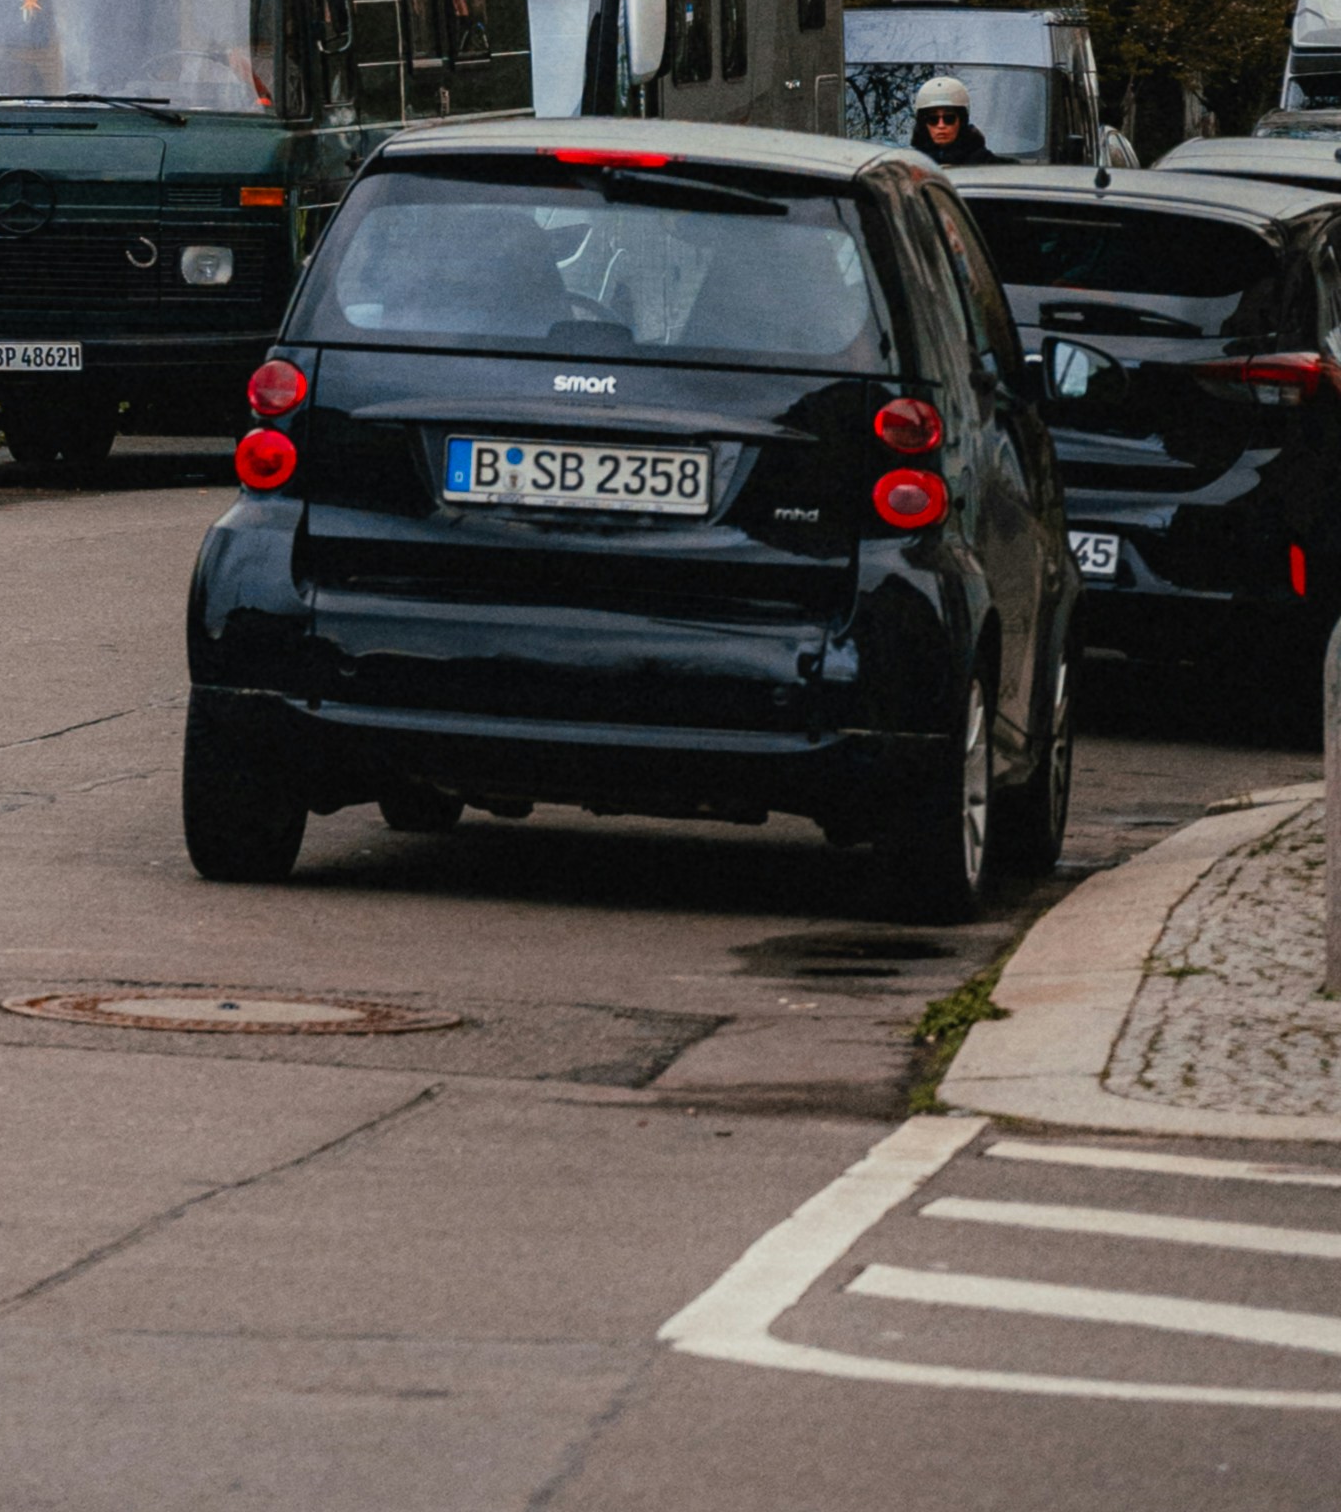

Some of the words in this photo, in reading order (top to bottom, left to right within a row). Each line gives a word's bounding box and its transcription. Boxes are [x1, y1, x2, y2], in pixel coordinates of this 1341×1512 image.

[21, 347, 80, 367] 4862H
[553, 374, 616, 394] smart
[475, 447, 500, 487] B
[531, 451, 584, 492] SB
[596, 455, 701, 499] 2358
